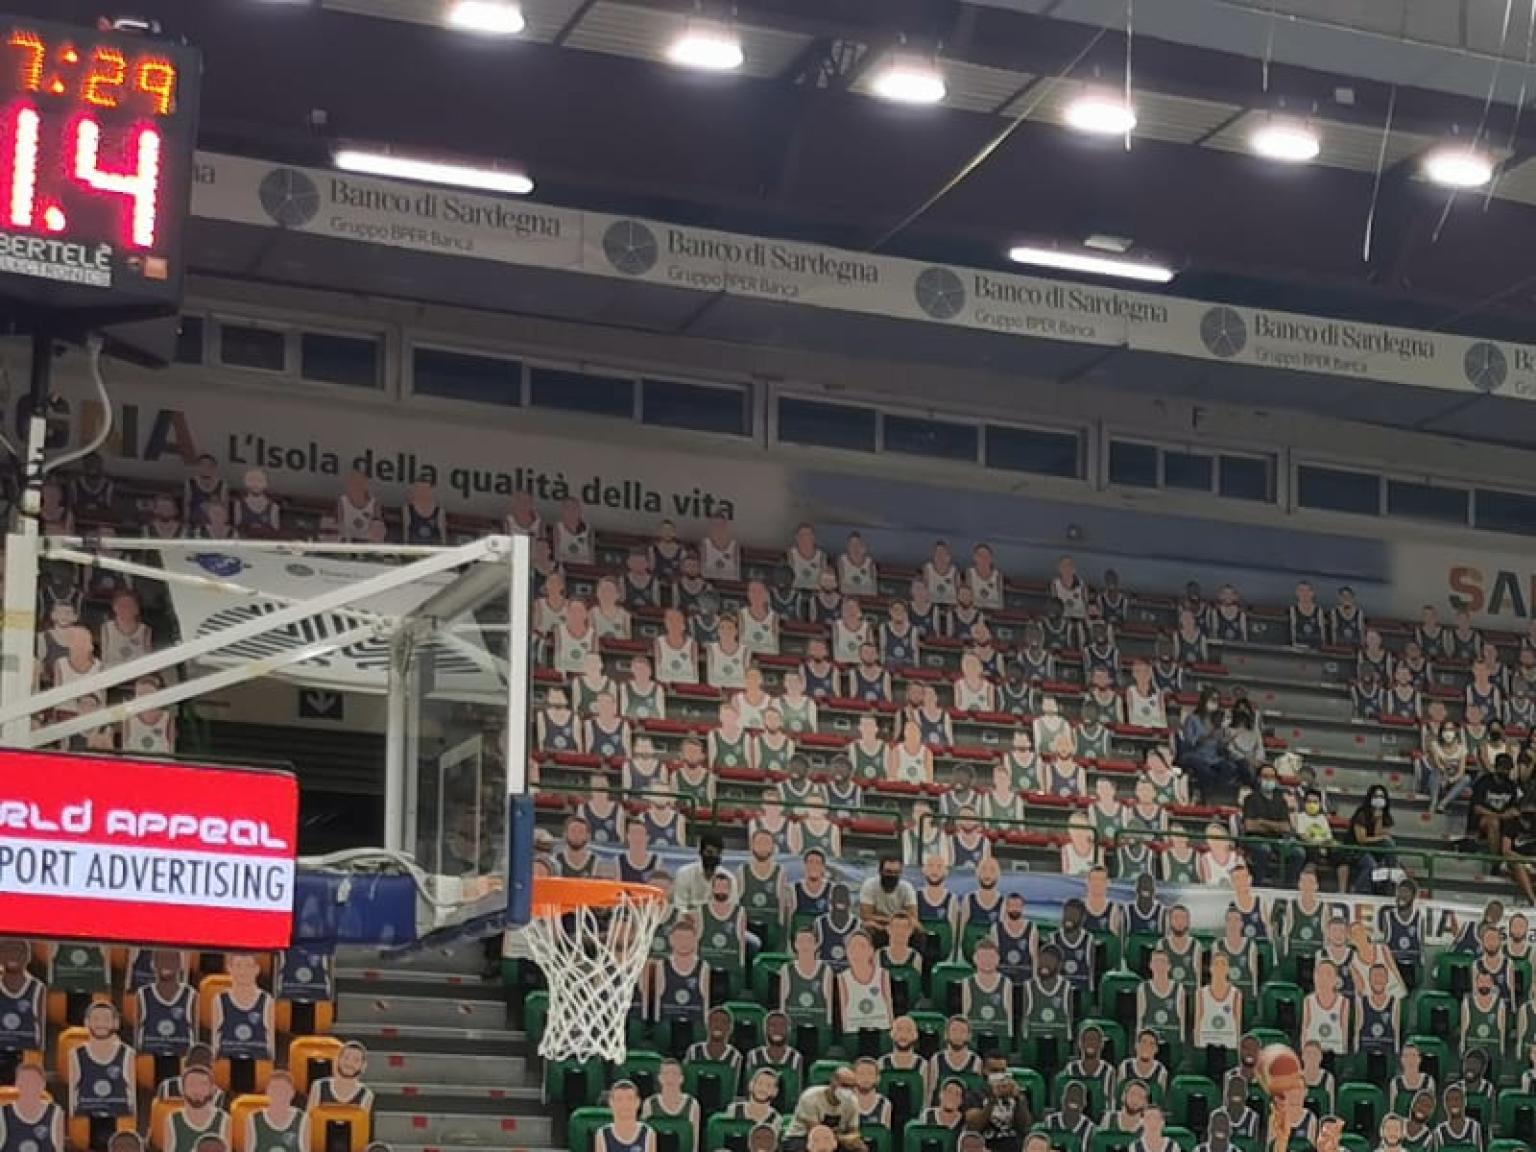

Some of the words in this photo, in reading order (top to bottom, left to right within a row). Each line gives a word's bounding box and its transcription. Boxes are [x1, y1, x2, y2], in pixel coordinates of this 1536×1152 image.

[8, 31, 177, 116] 7:29
[8, 104, 162, 248] 1.4
[330, 216, 388, 240] Gruppo
[431, 232, 474, 251] Banca
[331, 178, 410, 214] Banco
[415, 190, 438, 219] di
[444, 196, 561, 238] Sardegna
[667, 229, 741, 262] Banco
[744, 240, 766, 268] di
[771, 246, 879, 285] Sardegna
[974, 275, 1042, 304] Banco
[1045, 285, 1065, 309] di
[1068, 287, 1168, 323] Sardegna
[1255, 313, 1319, 344] Banco
[1320, 322, 1339, 347] di
[1342, 325, 1435, 359] Sardegna
[352, 449, 438, 487] della
[450, 467, 570, 499] qualità
[582, 476, 662, 513] della
[672, 488, 735, 521] vita
[86, 851, 286, 902] ADVERTISING
